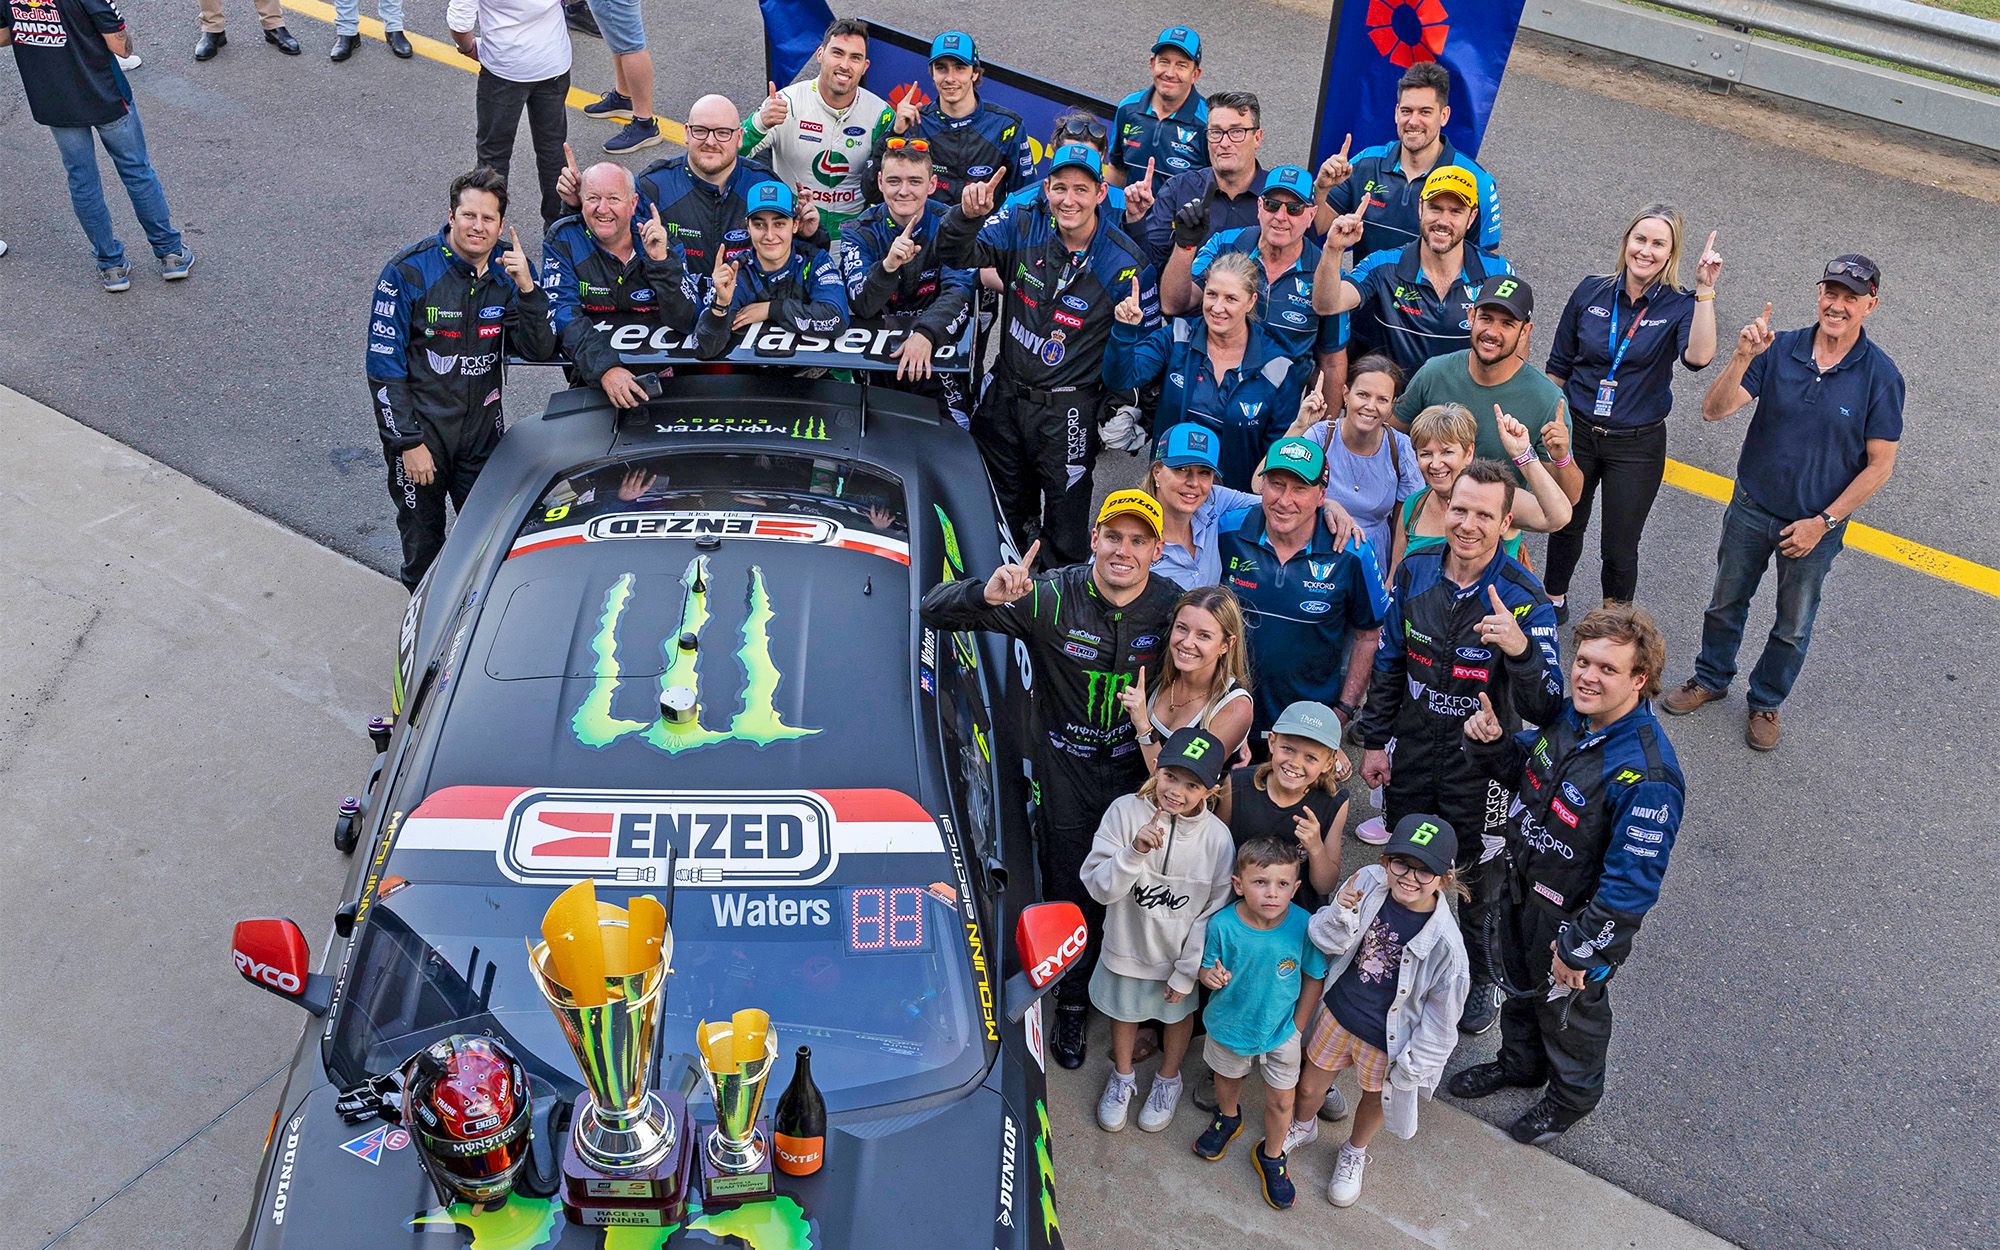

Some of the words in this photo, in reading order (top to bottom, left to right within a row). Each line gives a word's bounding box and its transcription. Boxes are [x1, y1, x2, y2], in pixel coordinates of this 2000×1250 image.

[11, 7, 36, 20] Red
[38, 9, 60, 22] Bull
[15, 32, 67, 43] RACING
[800, 122, 822, 132] RYCO
[1123, 124, 1131, 134] 6
[970, 166, 990, 175] Ford
[1364, 181, 1374, 191] 6
[1430, 174, 1472, 188] DUNLOP
[686, 249, 704, 257] strol
[1118, 269, 1136, 281] P1
[377, 279, 398, 297] Ford
[1394, 286, 1405, 298] 6
[1494, 279, 1518, 298] 6
[1064, 297, 1086, 309] Ford
[1400, 304, 1422, 315] Castrol
[483, 308, 503, 317] Ford
[1055, 313, 1082, 327] RYCO
[1285, 313, 1305, 322] Ford
[372, 320, 396, 336] dba
[480, 326, 500, 336] RYC
[1009, 317, 1045, 355] NAVY
[461, 365, 491, 376] RACING
[1067, 407, 1079, 463] TICKFORD
[396, 456, 404, 487] RACING
[1107, 498, 1160, 517] DUNLOP
[610, 518, 752, 535] ENZED
[1230, 557, 1238, 570] 6
[1234, 577, 1258, 589] Castrol
[1303, 580, 1336, 590] TICKFORD
[1303, 601, 1327, 612] Ford
[1514, 604, 1532, 619] P1
[1531, 627, 1554, 638] NAVY
[921, 628, 936, 669] Waters
[1133, 637, 1157, 648] Ford
[1075, 647, 1095, 657] ENZED
[1461, 648, 1486, 660] Ford
[1454, 668, 1487, 679] RYCO
[1429, 701, 1466, 716] RACING
[1182, 737, 1210, 760] 6
[1616, 769, 1642, 784] P1
[1564, 785, 1583, 804] Ford
[1484, 779, 1500, 832] TICKFOR
[1499, 789, 1510, 825] RACING
[1553, 801, 1576, 825] RYCO
[1632, 806, 1658, 820] NAVY
[616, 813, 804, 859] ENZED
[1409, 822, 1439, 846] 6
[939, 814, 974, 920] electrical
[711, 893, 831, 927] Waters
[1031, 925, 1088, 986] RYCO
[232, 949, 300, 993] RYCO
[324, 925, 359, 1041] electrical
[498, 1078, 508, 1102] TRADIE
[436, 1097, 457, 1117] TRADIE
[419, 1107, 435, 1124] ENZED
[475, 1117, 498, 1130] ENZED
[453, 1126, 516, 1153] MONSTER
[775, 1145, 820, 1164] FOXTEL
[1000, 1116, 1016, 1212] DUNLOP
[272, 1134, 299, 1225] DUNLOP
[594, 1216, 650, 1224] WINNER
